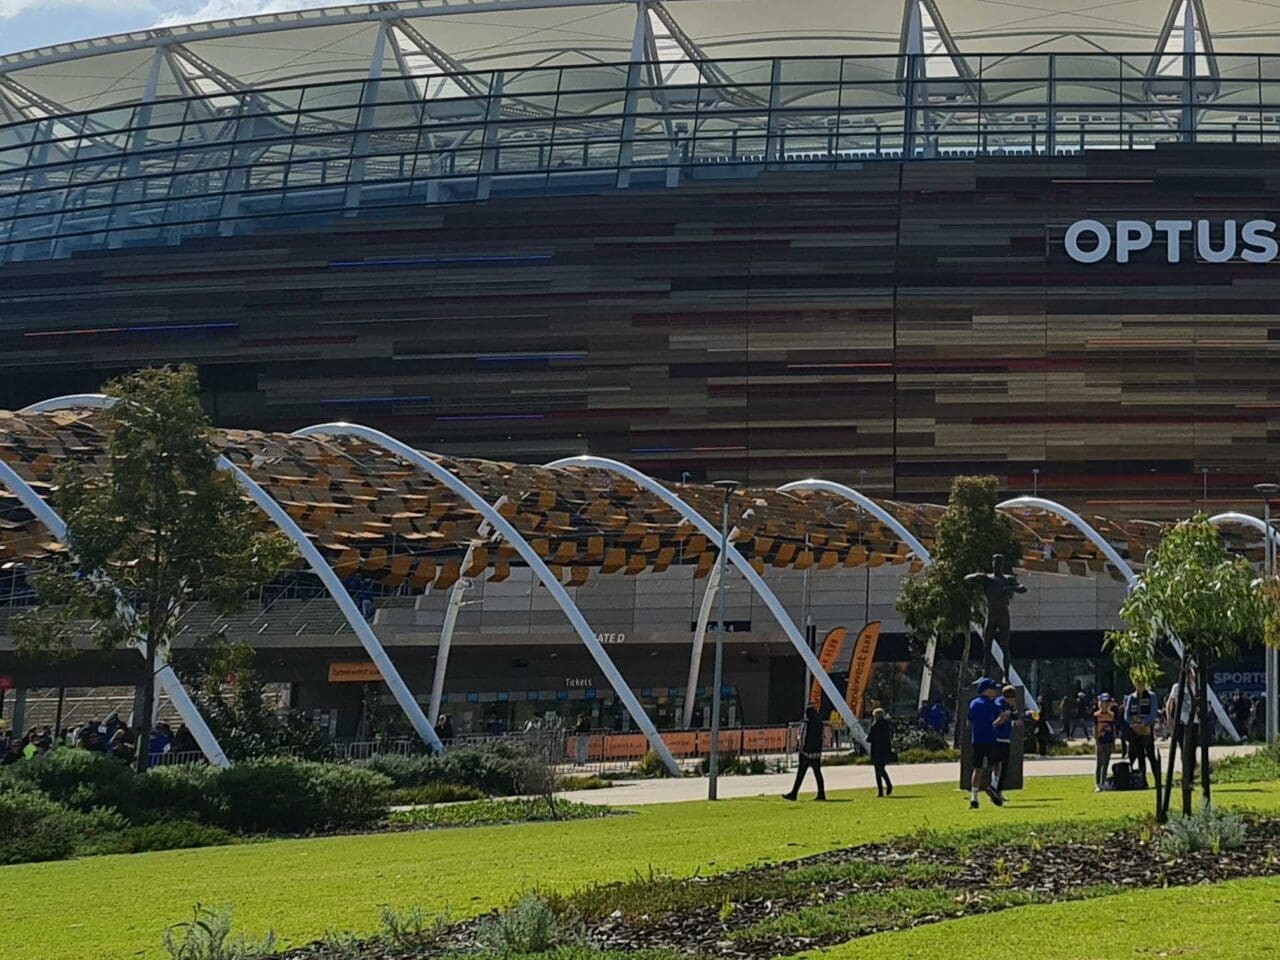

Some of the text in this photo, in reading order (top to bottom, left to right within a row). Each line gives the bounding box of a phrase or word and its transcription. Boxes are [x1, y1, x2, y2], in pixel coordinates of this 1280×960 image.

[1064, 219, 1279, 264] OPTUS
[595, 633, 625, 643] ATE D
[565, 678, 592, 687] Tickets
